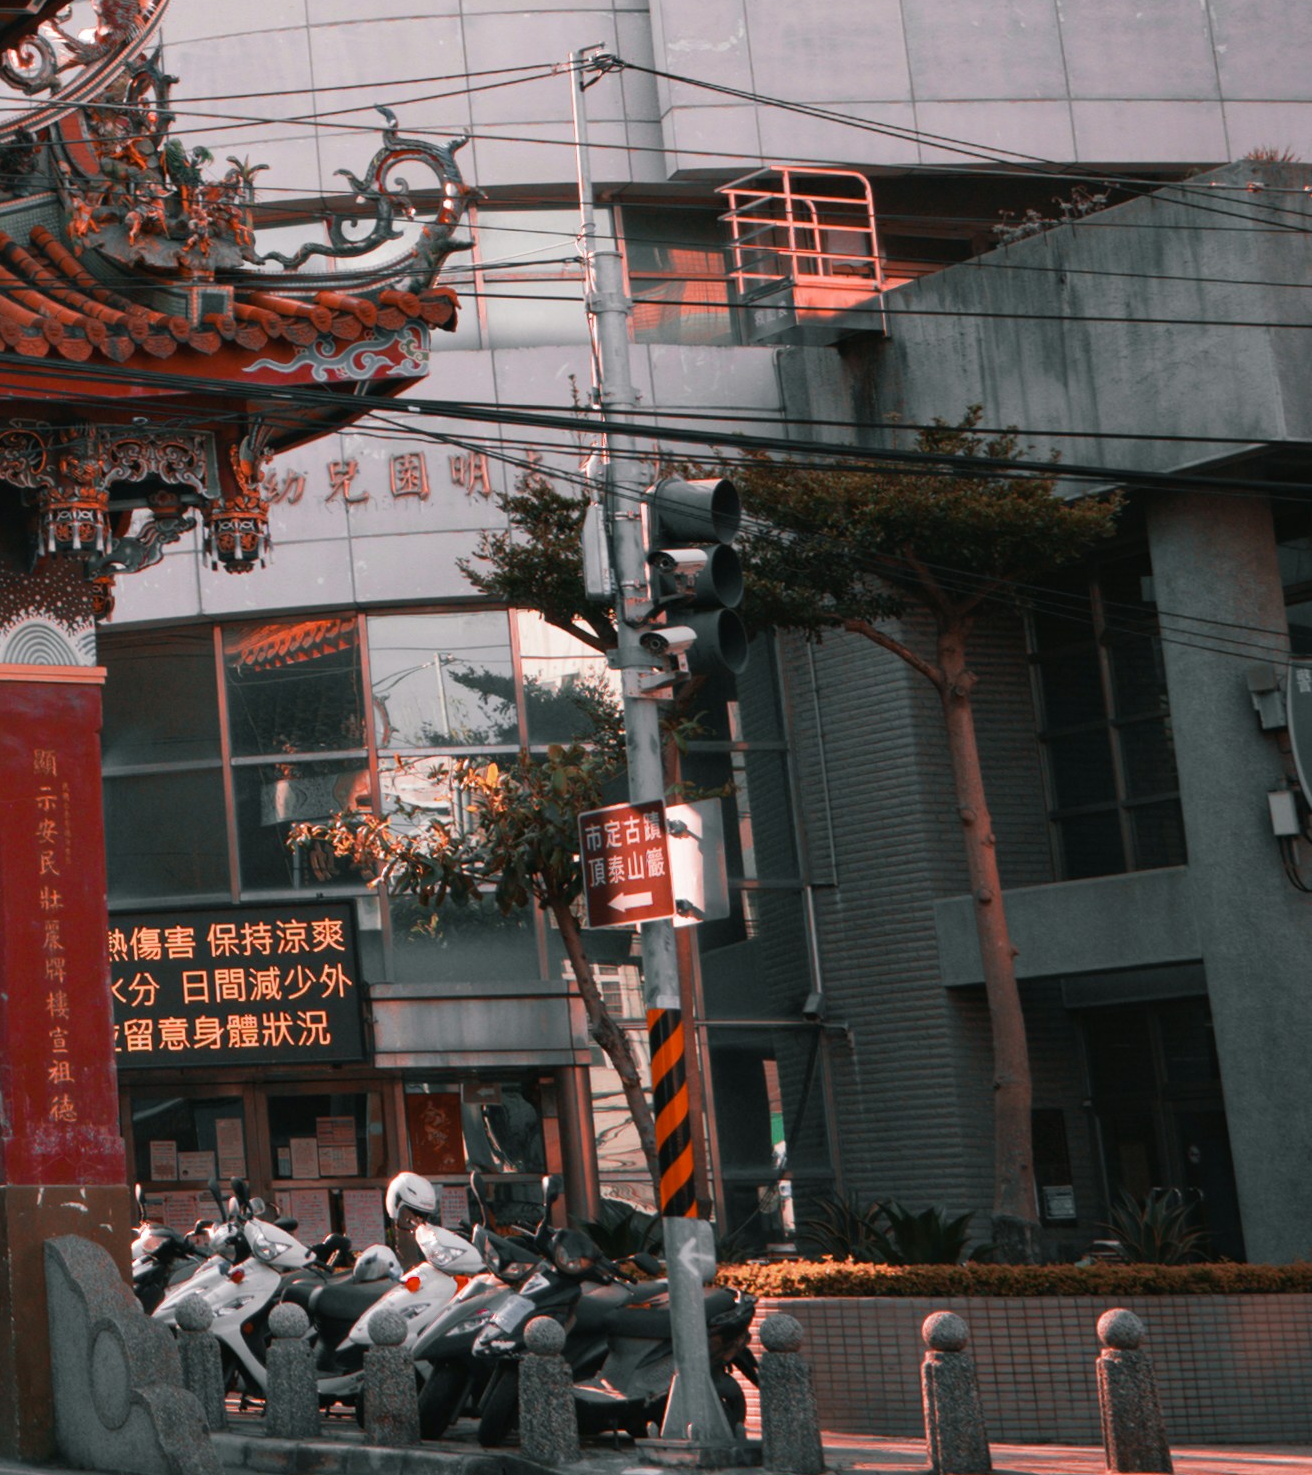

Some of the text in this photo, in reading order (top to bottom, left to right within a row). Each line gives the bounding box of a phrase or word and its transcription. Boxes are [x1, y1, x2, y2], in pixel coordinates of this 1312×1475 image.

[584, 810, 662, 852] 市定古蹟
[207, 917, 346, 958] 保持涼爽
[181, 963, 353, 1005] 日間減少外
